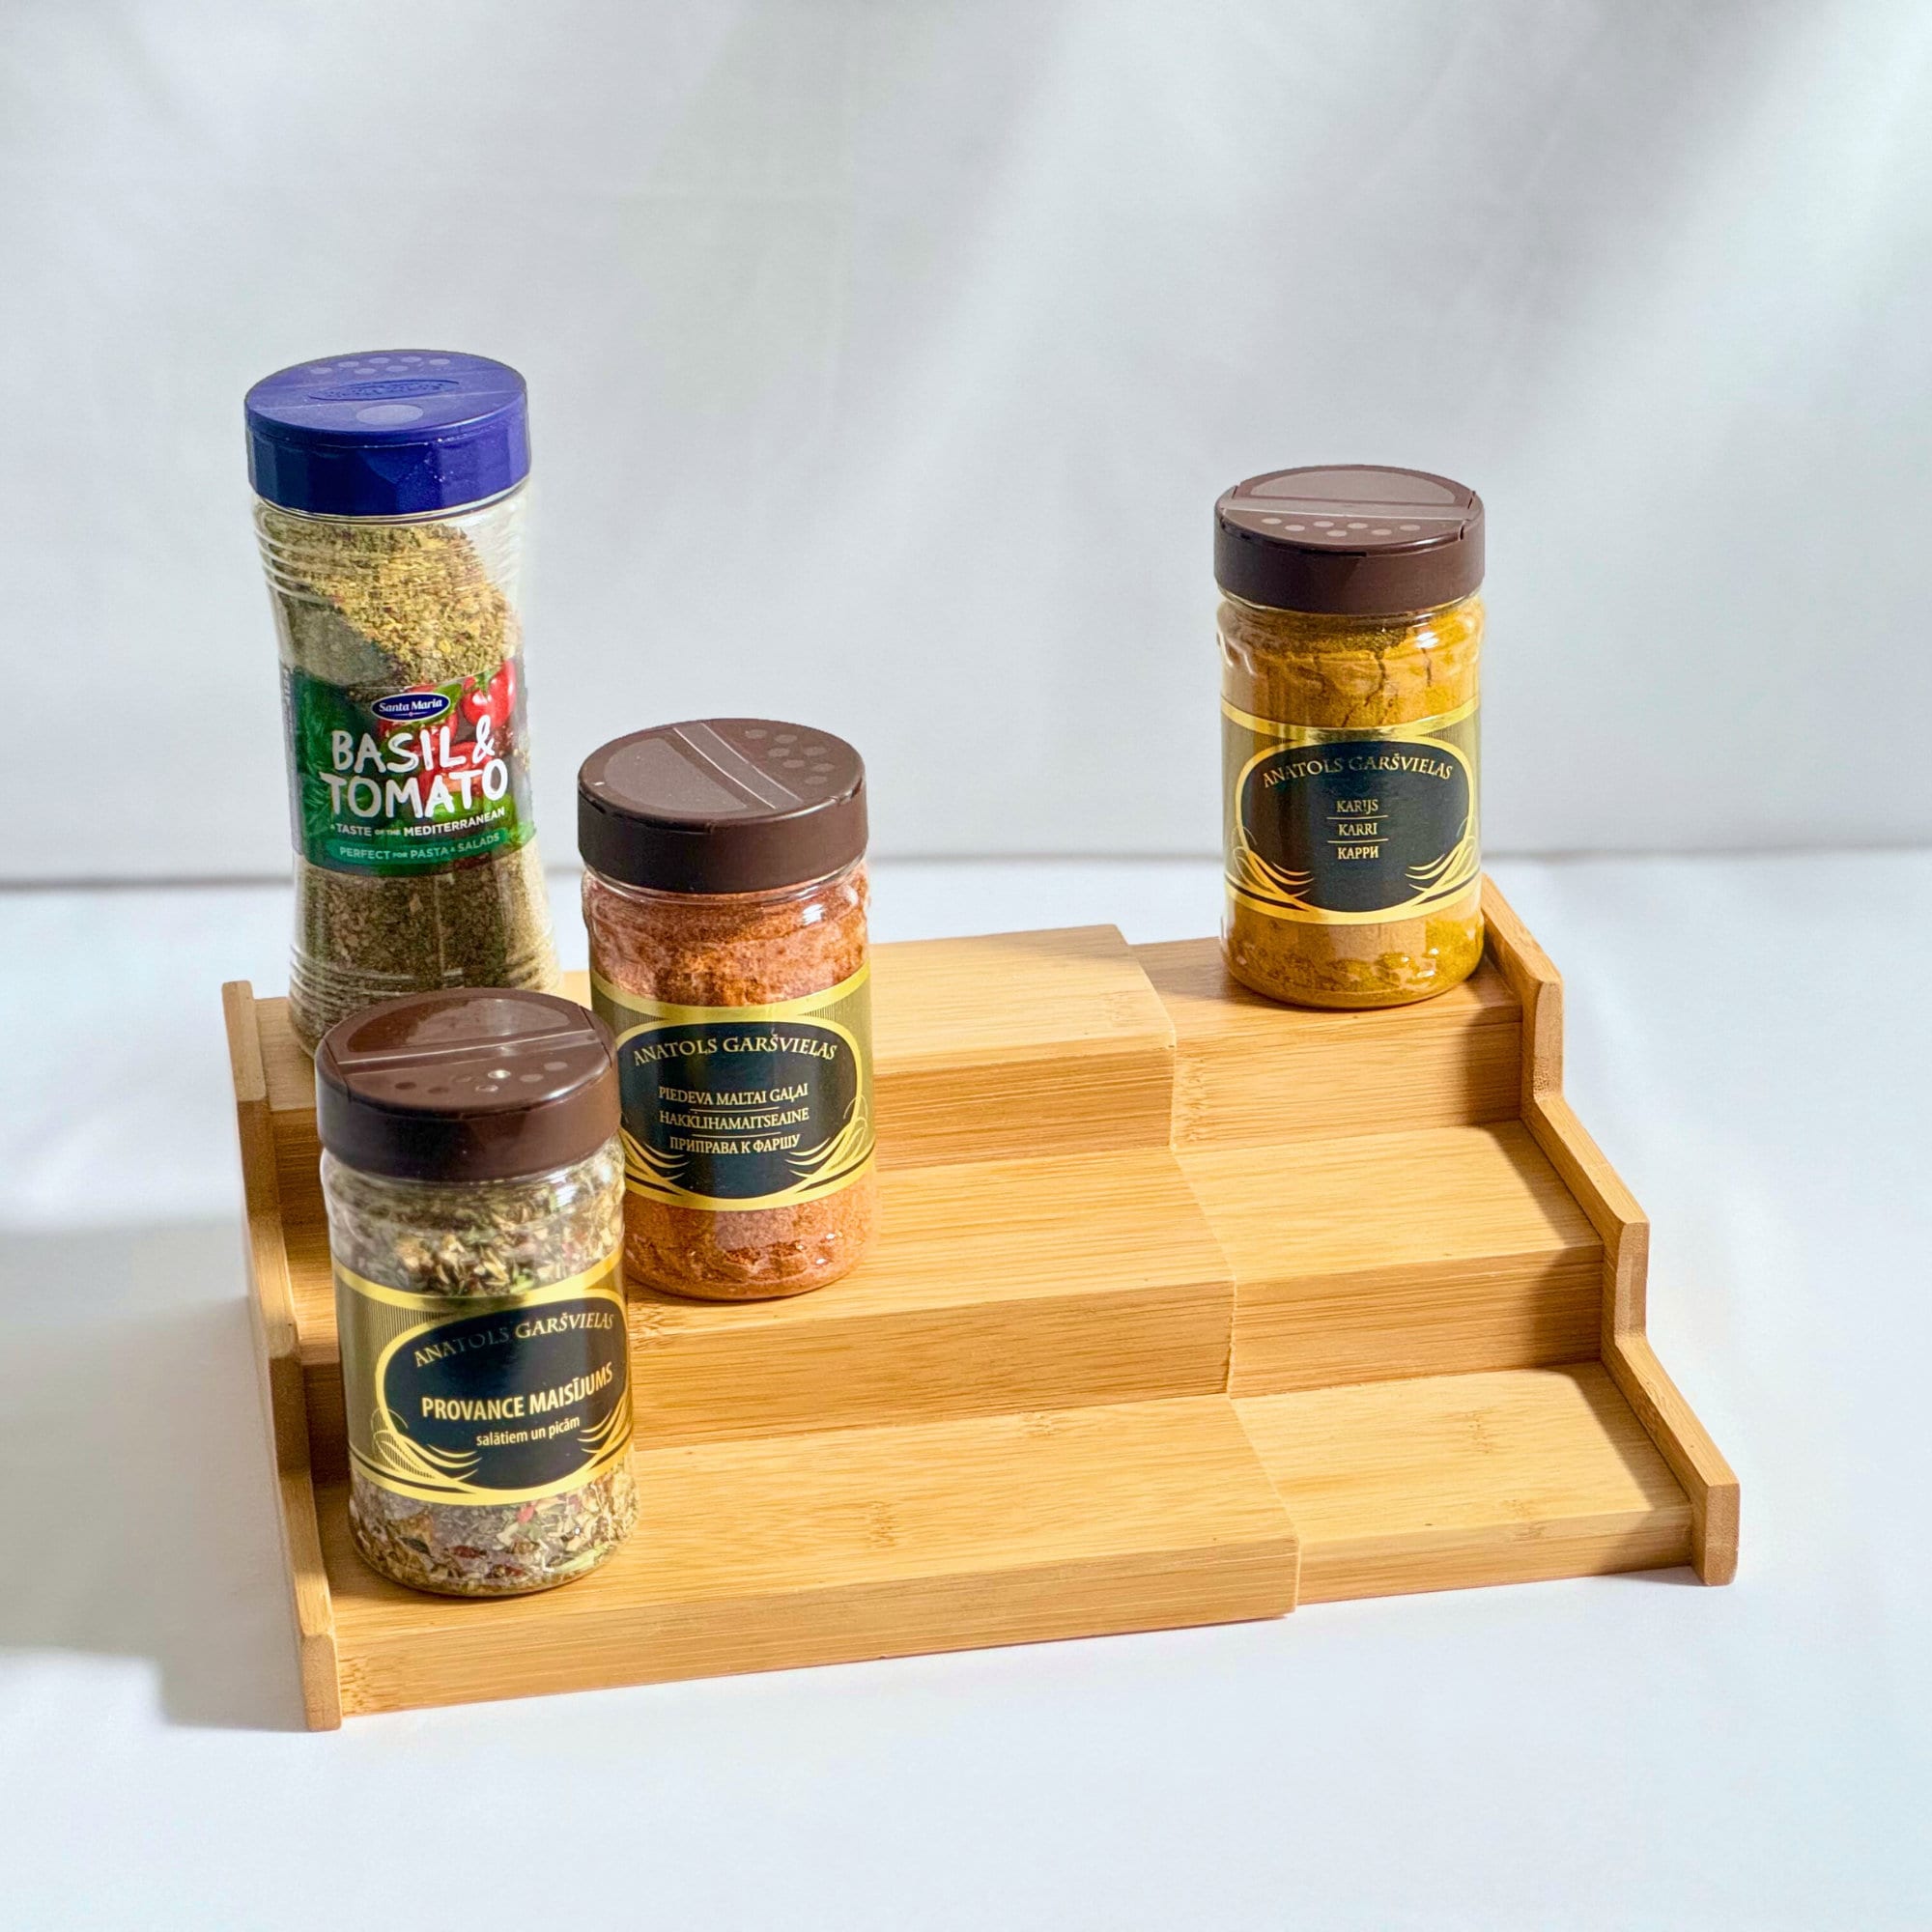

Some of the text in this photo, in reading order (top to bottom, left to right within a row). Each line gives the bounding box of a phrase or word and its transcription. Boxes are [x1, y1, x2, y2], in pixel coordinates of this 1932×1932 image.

[378, 697, 443, 713] Santa Maria
[331, 714, 496, 774] BASIL &
[1262, 753, 1453, 788] ANATOLS GARŠVIELAS
[319, 758, 509, 818] TOMATO
[1336, 799, 1379, 815] KARIJS
[335, 822, 373, 838] TASTE
[403, 807, 505, 838] MEDITERRANEAN
[1338, 822, 1378, 837] KARRI
[339, 846, 391, 860] PERFECT
[410, 847, 450, 860] PASTA
[457, 833, 500, 853] SALADS
[1337, 845, 1379, 860] КАРРИ
[634, 1033, 838, 1066] ANATOLS GARŠVIELAS
[659, 1086, 714, 1106] PIEDEVA
[716, 1091, 767, 1106] MALTAI
[659, 1107, 810, 1130] HAKKLIHAMAITSEAINE
[669, 1133, 802, 1154] ПРИПРАВА К ФАРШУ
[413, 1311, 614, 1368] ANATOLS GARŠVIELAS
[421, 1361, 613, 1421] PROVANCE MAISĪJUMS
[476, 1416, 581, 1447] salātiem un picām
